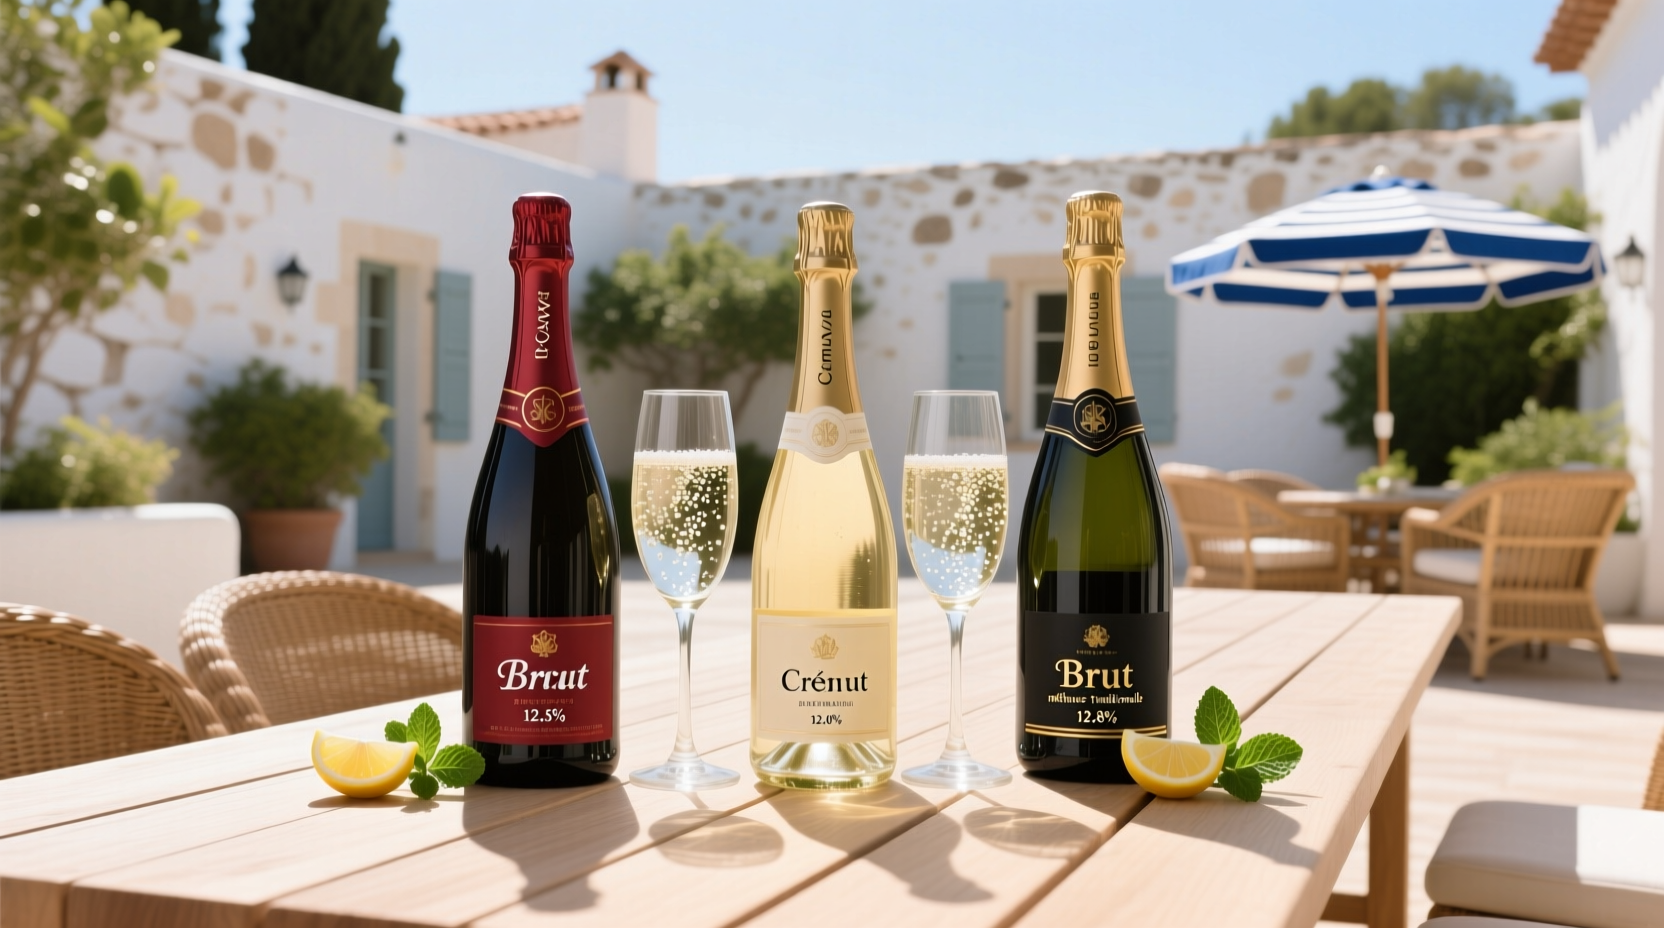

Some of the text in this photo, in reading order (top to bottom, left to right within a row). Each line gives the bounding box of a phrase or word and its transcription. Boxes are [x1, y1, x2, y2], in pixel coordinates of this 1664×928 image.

[781, 668, 868, 692] Crénut
[1055, 659, 1134, 689] Brut
[523, 708, 566, 722] 12.5%
[811, 714, 842, 725] 12.0%
